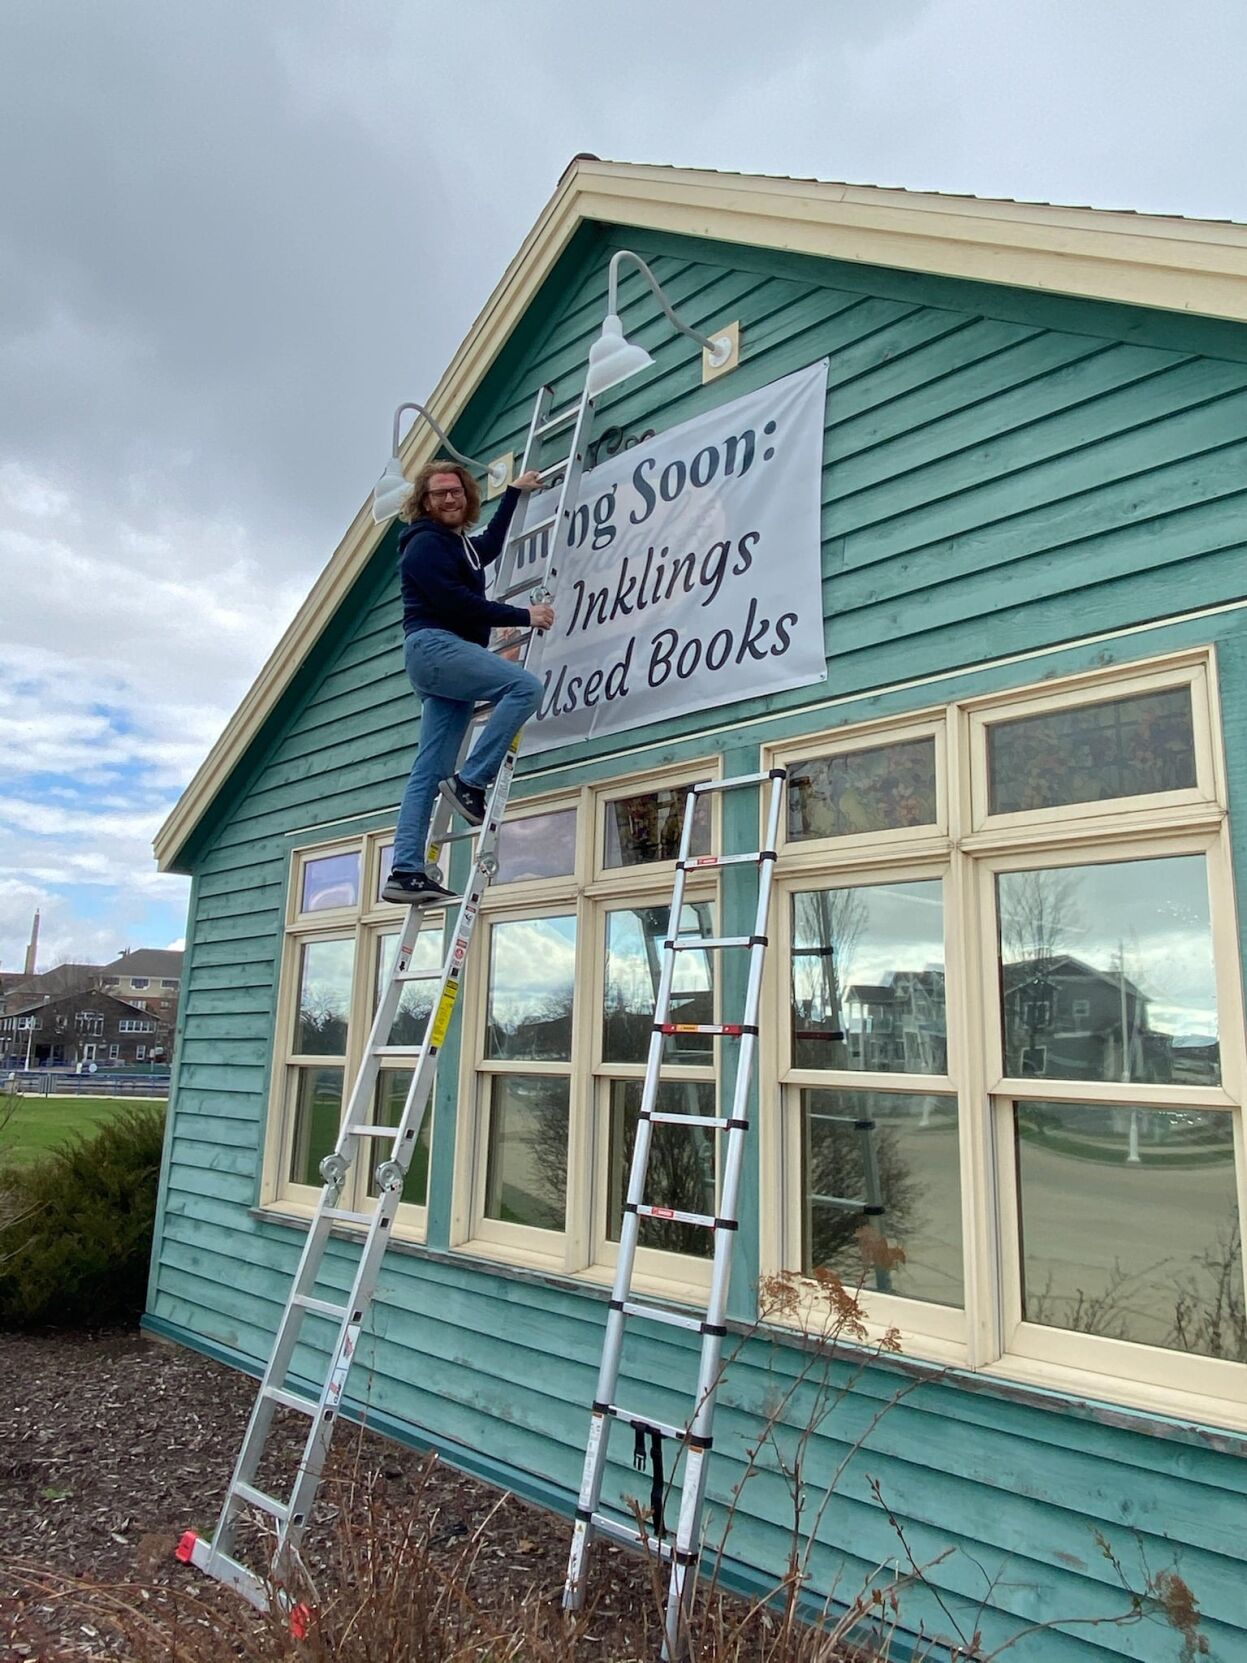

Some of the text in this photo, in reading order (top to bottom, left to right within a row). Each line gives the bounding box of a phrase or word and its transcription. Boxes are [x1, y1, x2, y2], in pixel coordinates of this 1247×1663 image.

[629, 420, 777, 525] Soon:
[566, 531, 760, 637] Inklings
[536, 598, 799, 721] Used Books
